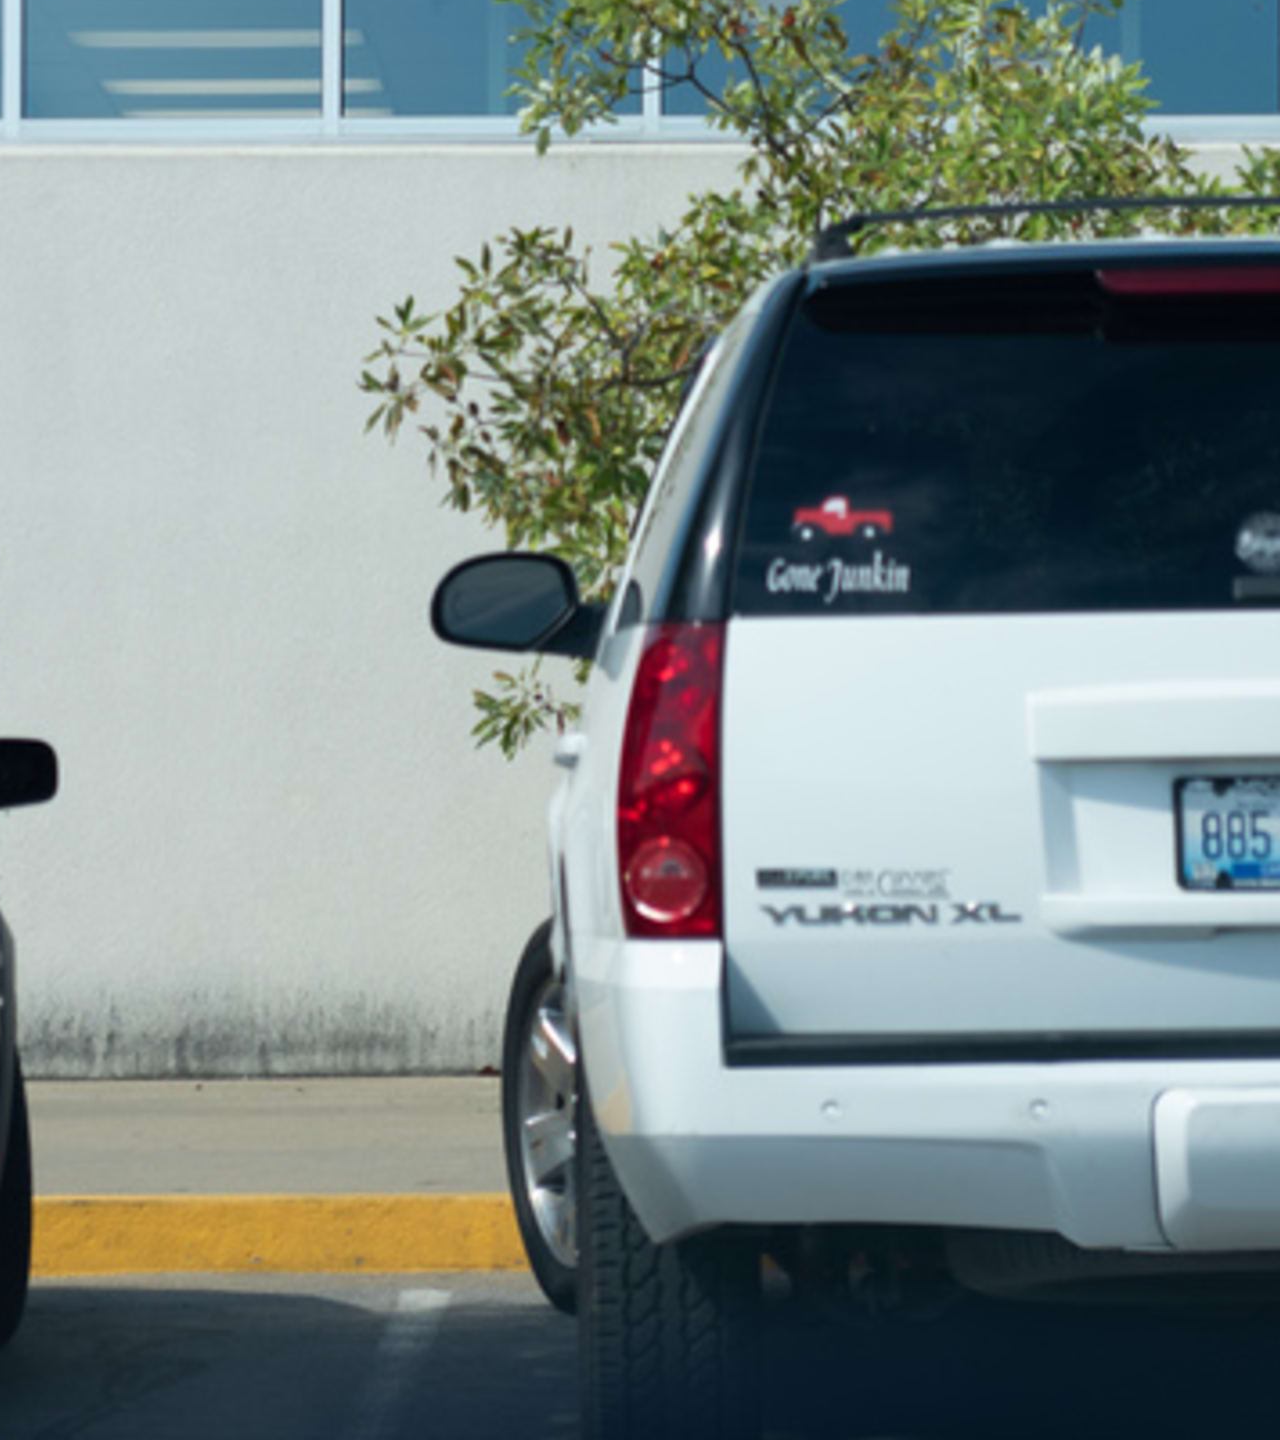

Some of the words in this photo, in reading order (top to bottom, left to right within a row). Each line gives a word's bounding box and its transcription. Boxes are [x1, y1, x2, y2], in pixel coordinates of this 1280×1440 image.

[766, 558, 823, 593] Gone
[823, 550, 911, 604] Junkin
[1200, 811, 1272, 860] 885
[760, 903, 940, 927] YUKON
[949, 902, 1024, 925] XL
